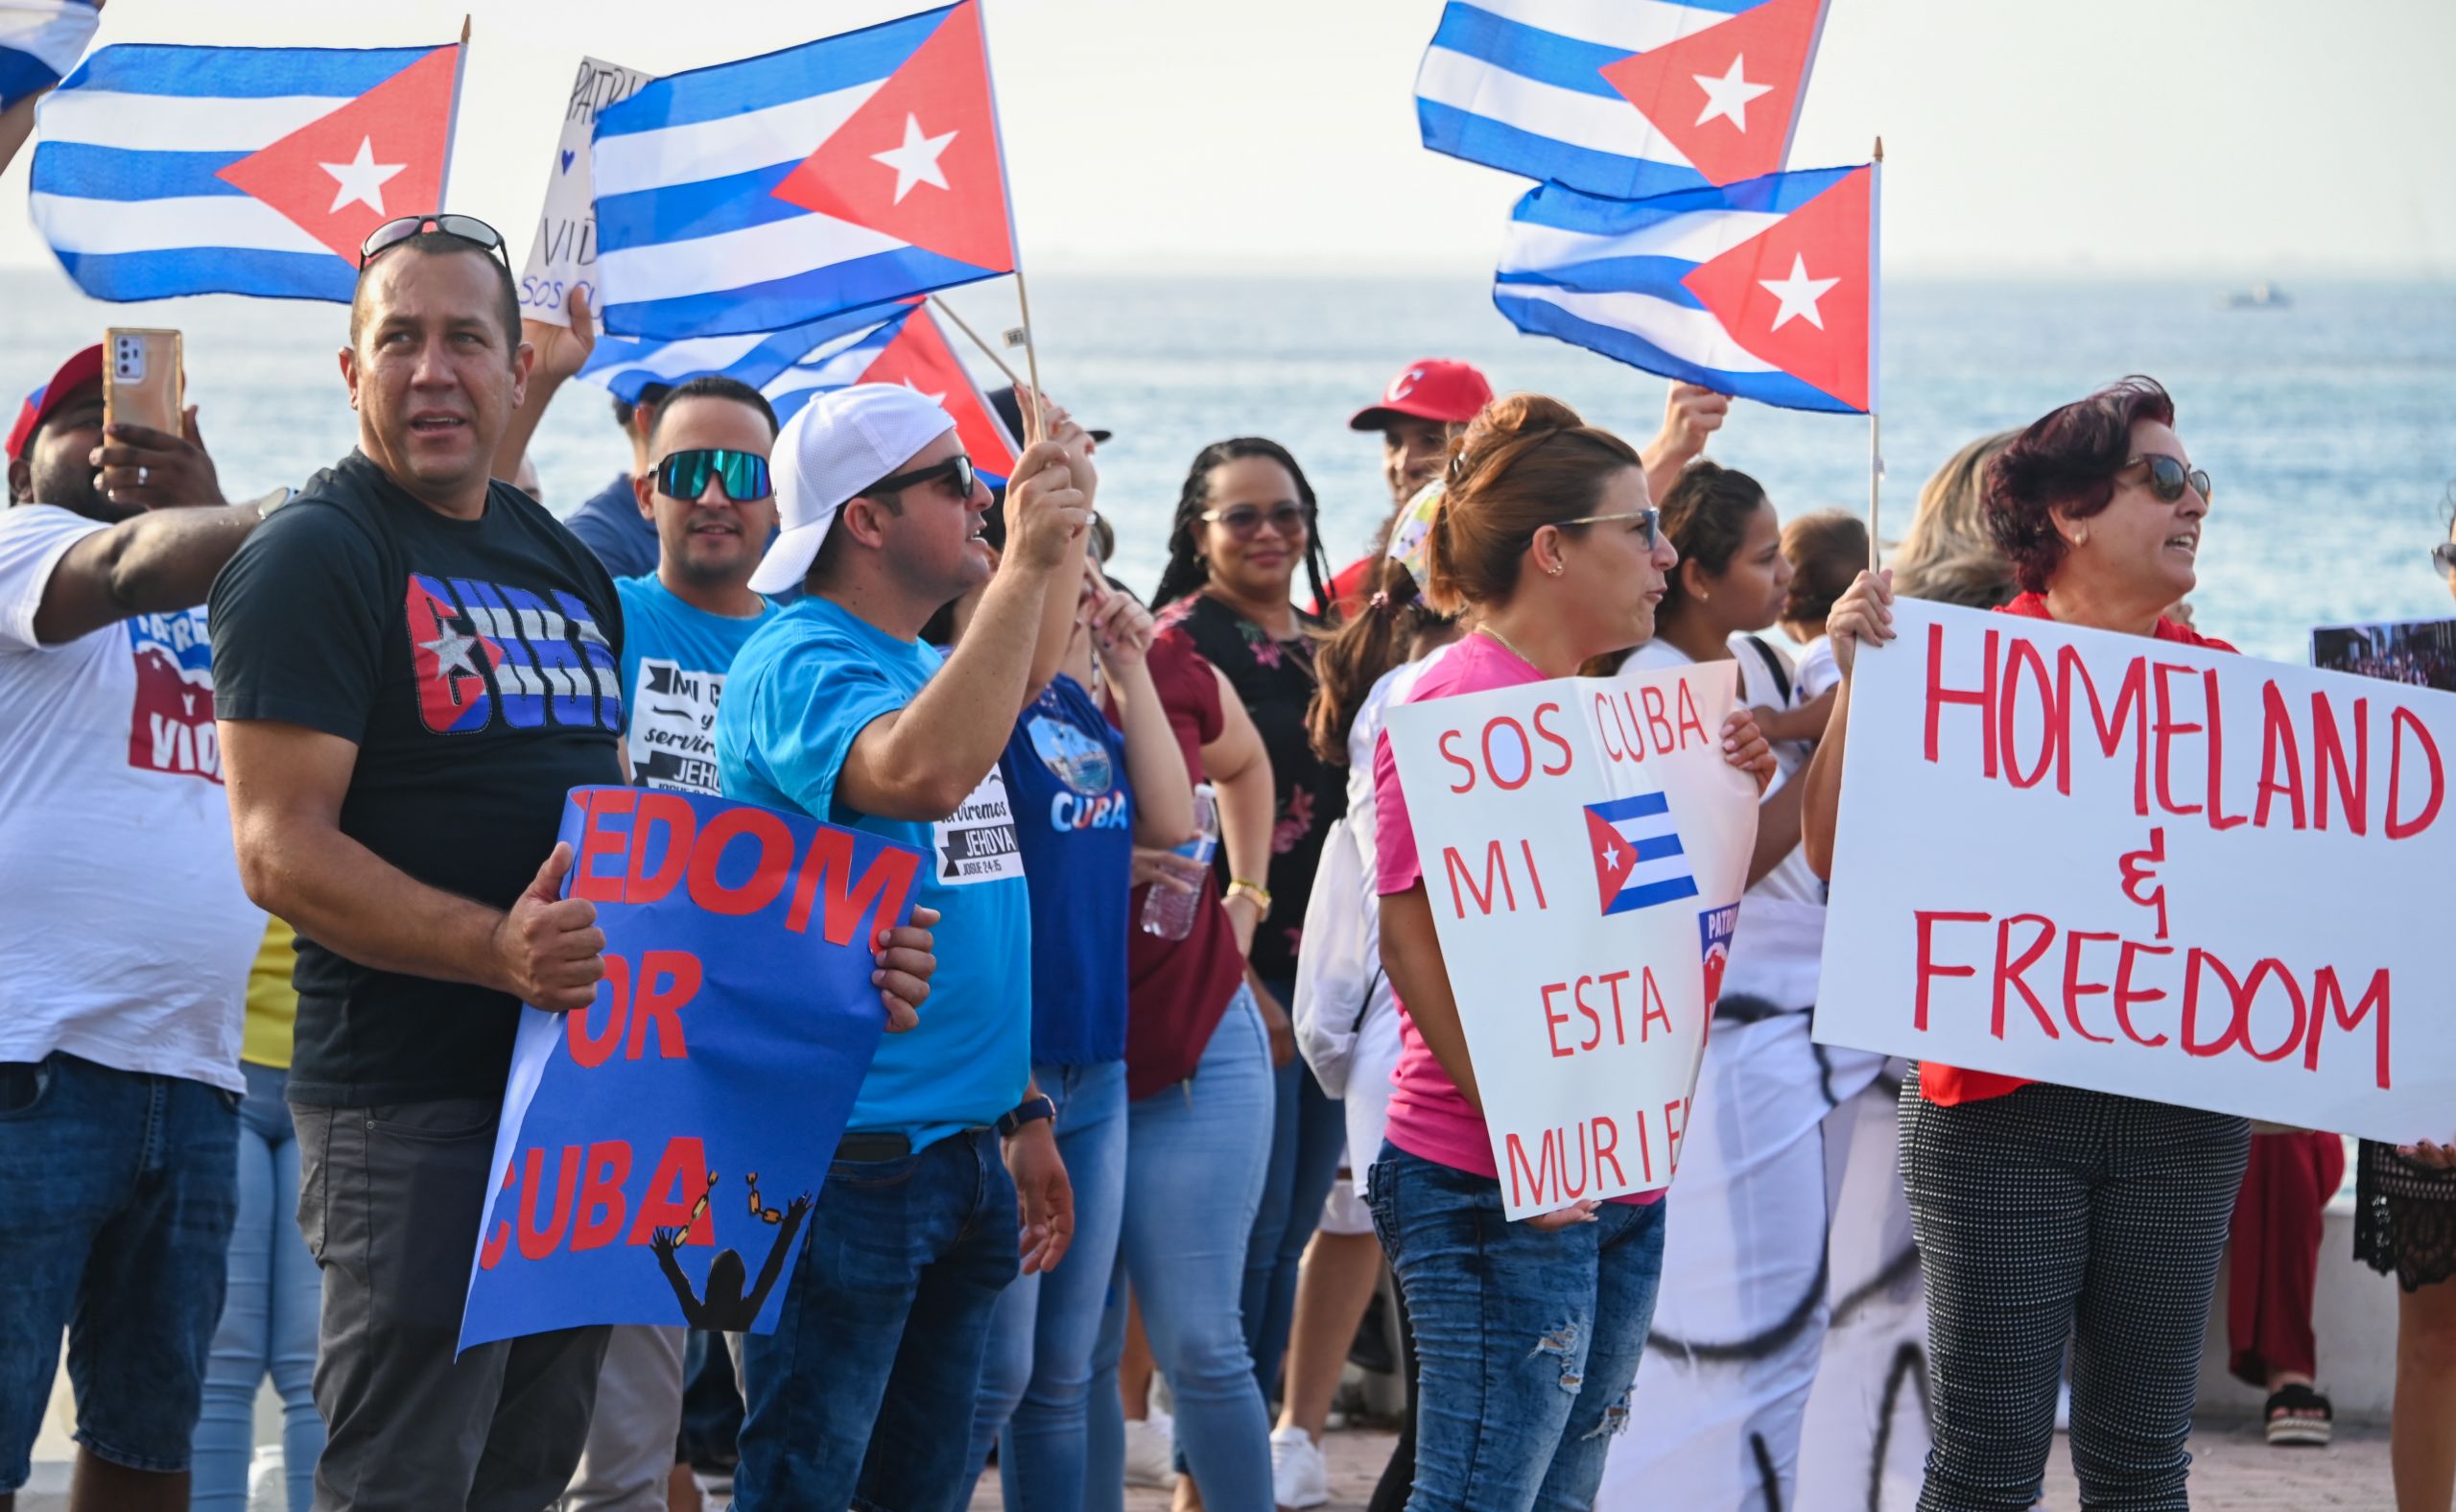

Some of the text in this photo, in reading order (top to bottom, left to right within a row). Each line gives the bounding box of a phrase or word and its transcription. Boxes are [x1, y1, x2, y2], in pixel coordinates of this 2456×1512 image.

[519, 275, 563, 310] SOS
[1387, 368, 1427, 401] C
[405, 573, 624, 736] CUBA
[673, 669, 699, 703] MI
[181, 693, 196, 717] Y
[1438, 677, 1710, 794] SOS CUBA
[1924, 623, 2445, 840] HOMELAND
[964, 825, 1017, 858] JEHOVA
[1050, 790, 1129, 832] CUBA
[1442, 839, 1547, 920] MI
[2118, 827, 2168, 939] &
[1540, 965, 1672, 1058] ESTA
[1913, 910, 2392, 1091] FREEDOM
